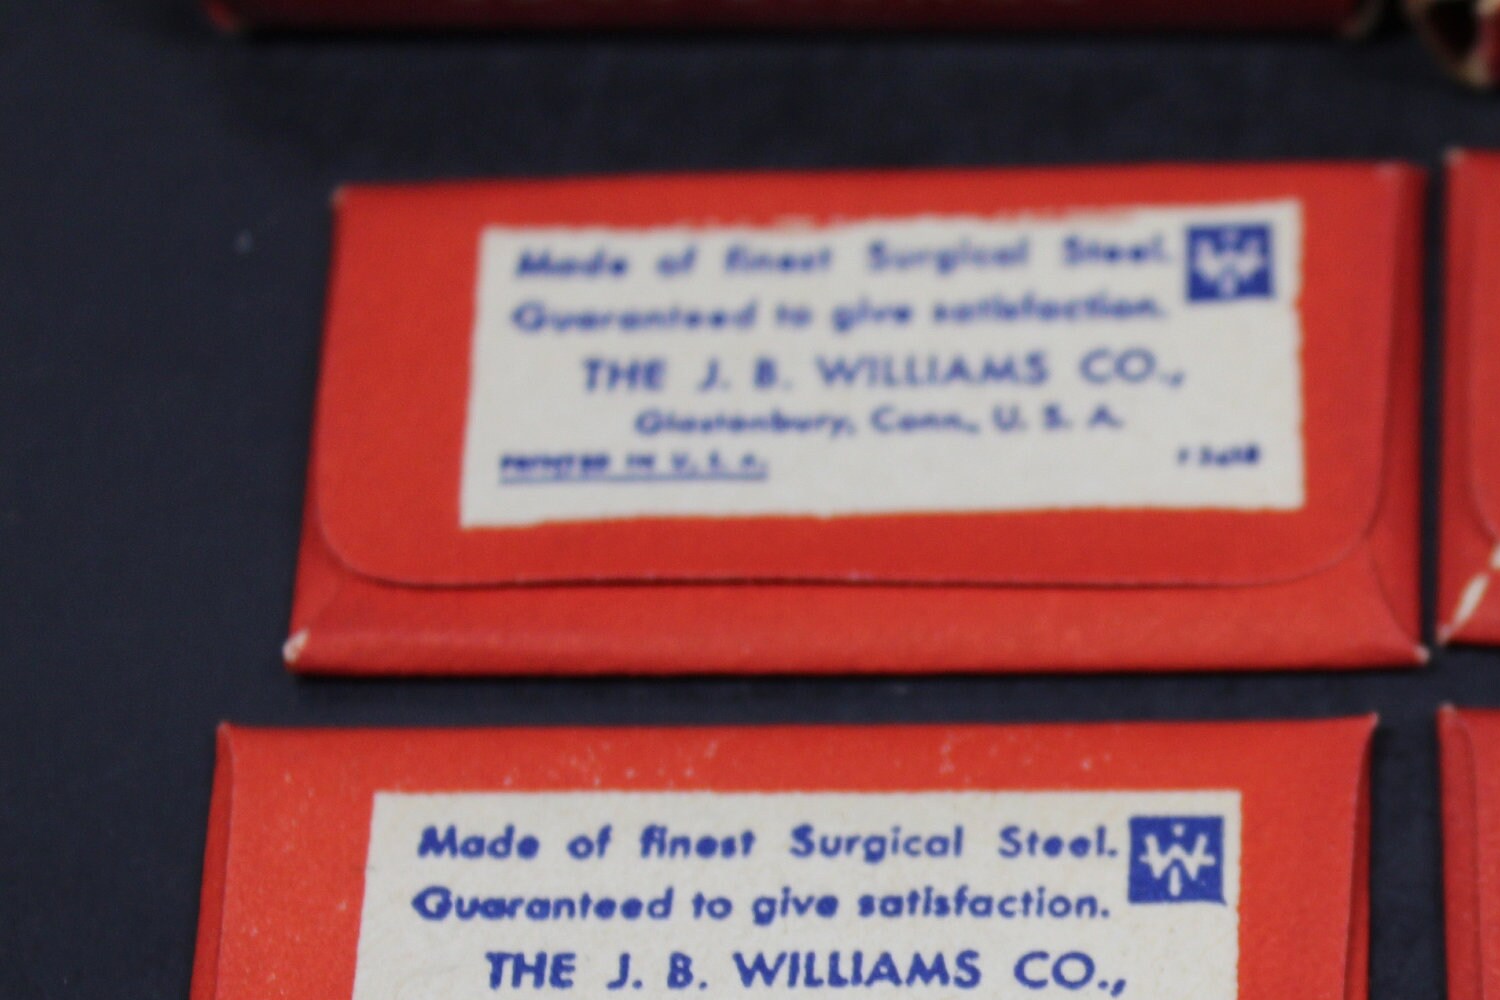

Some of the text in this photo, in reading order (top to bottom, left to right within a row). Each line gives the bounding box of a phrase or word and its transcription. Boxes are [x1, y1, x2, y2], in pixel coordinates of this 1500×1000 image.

[514, 235, 1173, 278] Made of finest Surgical Steel.
[512, 294, 1168, 334] Guaranteed to give satisfaction.
[583, 348, 1184, 392] THE J. B. WILLIAMS CO.,
[633, 409, 854, 437] Glastonbury,
[1042, 403, 1071, 430] S.
[417, 823, 1118, 865] Made of finest Surgical Steel.
[410, 884, 1110, 927] Guaranteed to give satisfaction.
[484, 948, 1127, 998] THE J. B. WILLIAMS CO.,
